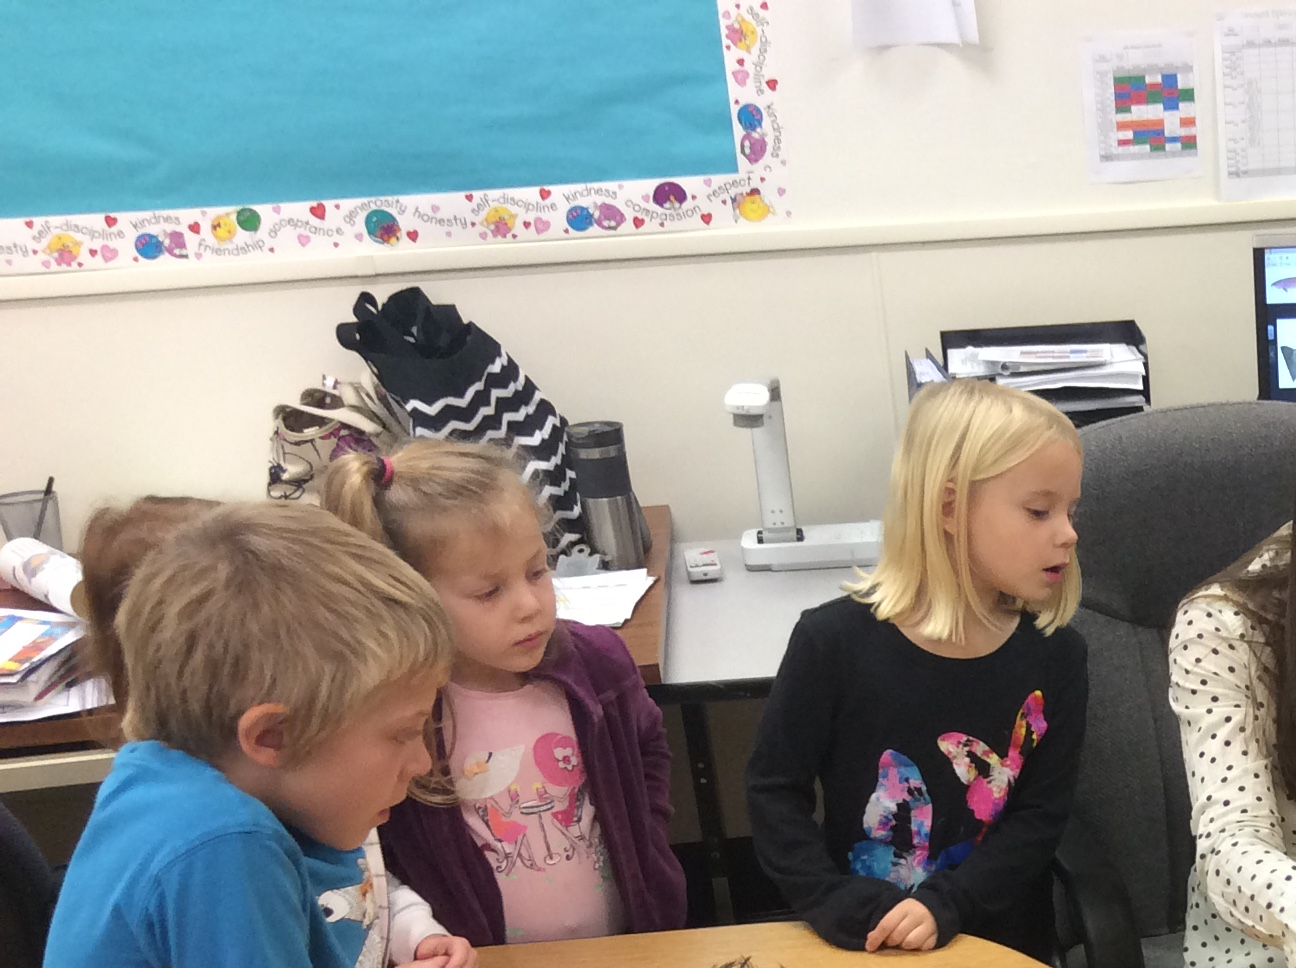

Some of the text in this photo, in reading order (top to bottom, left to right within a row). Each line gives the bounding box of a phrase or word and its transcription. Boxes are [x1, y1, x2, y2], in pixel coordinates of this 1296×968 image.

[746, 5, 771, 97] self-discipline
[764, 101, 783, 159] kindness
[562, 184, 618, 205] kindness
[706, 174, 753, 203] respect
[343, 198, 408, 227] generosity
[412, 205, 468, 229] honesty
[470, 193, 559, 218] self-discipline
[625, 198, 702, 223] compassion
[32, 218, 126, 244] self-discipline
[268, 216, 344, 239] acceptance
[198, 237, 265, 257] friendship
